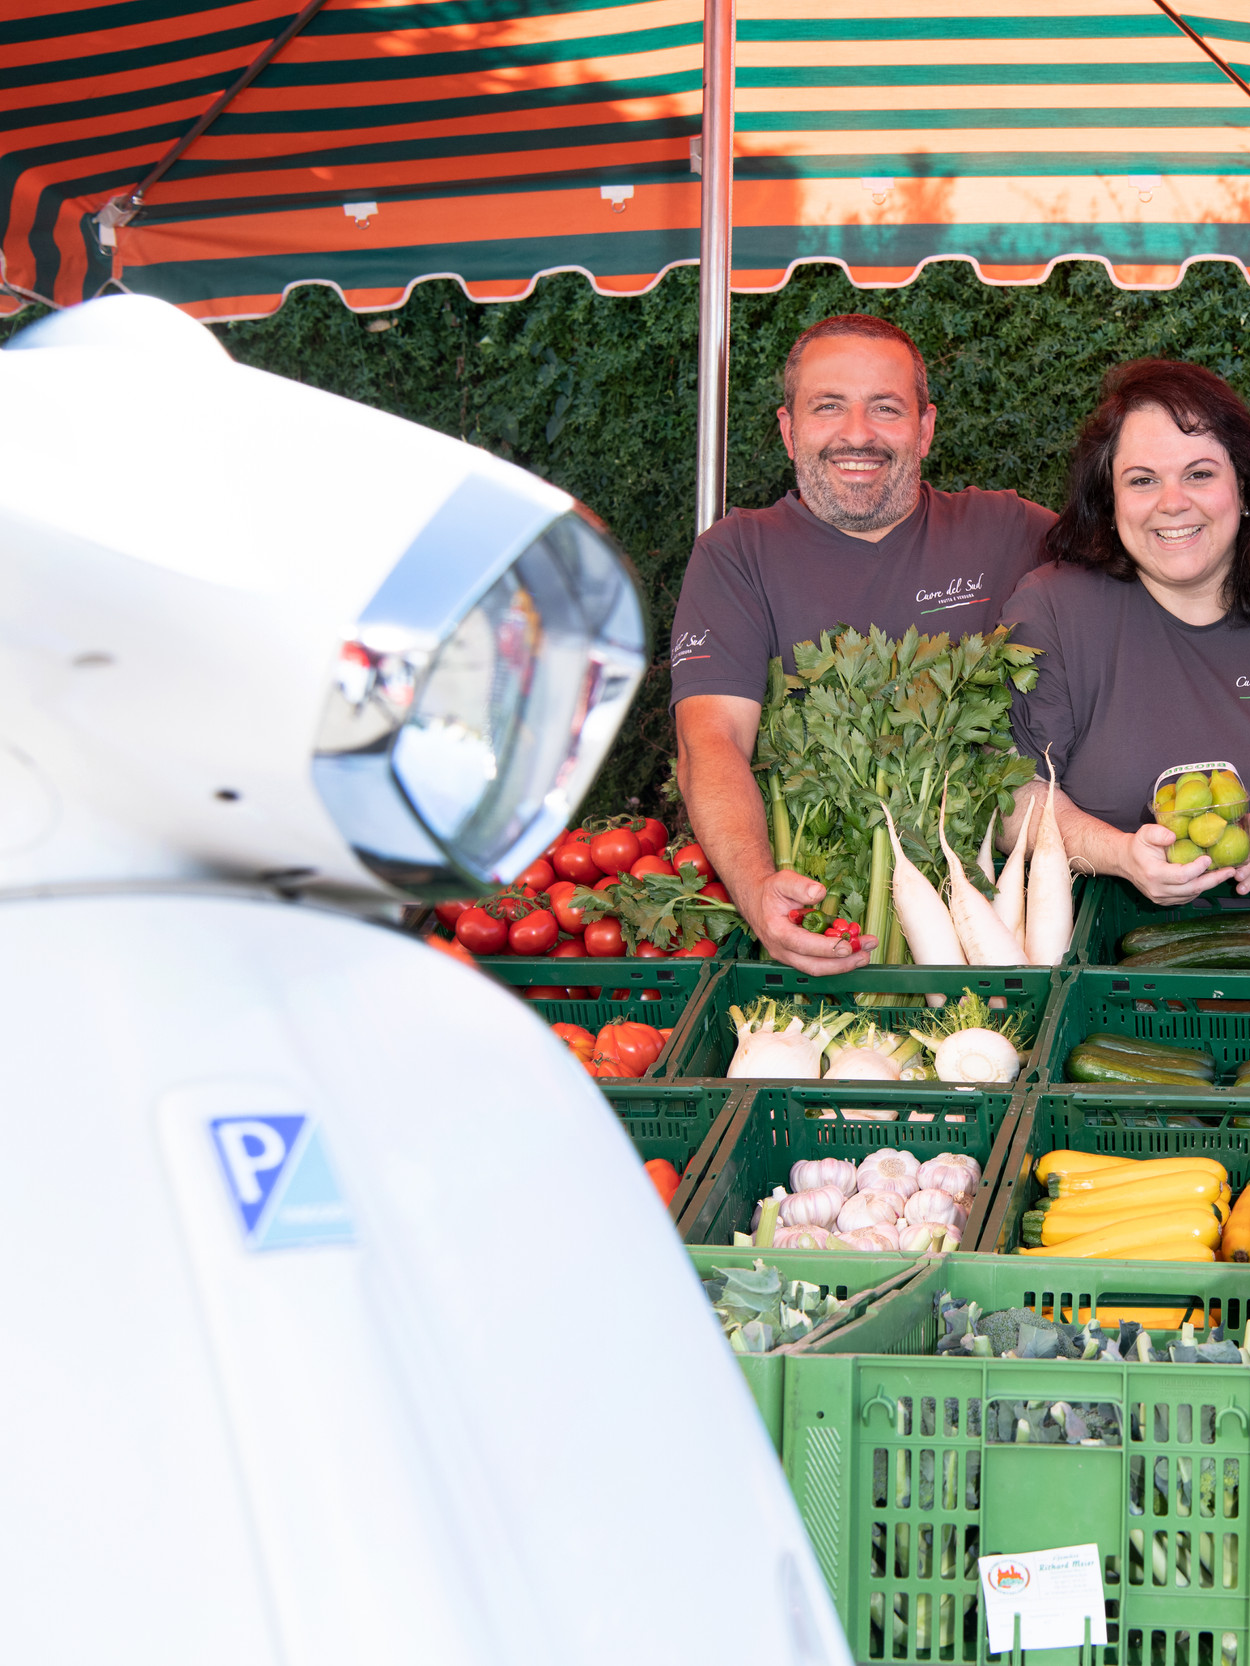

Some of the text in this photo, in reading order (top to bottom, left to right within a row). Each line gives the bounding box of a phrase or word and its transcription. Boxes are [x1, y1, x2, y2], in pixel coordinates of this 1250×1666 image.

[916, 572, 984, 602] Cuore del Sud
[686, 629, 710, 647] Sud
[218, 1121, 287, 1204] P
